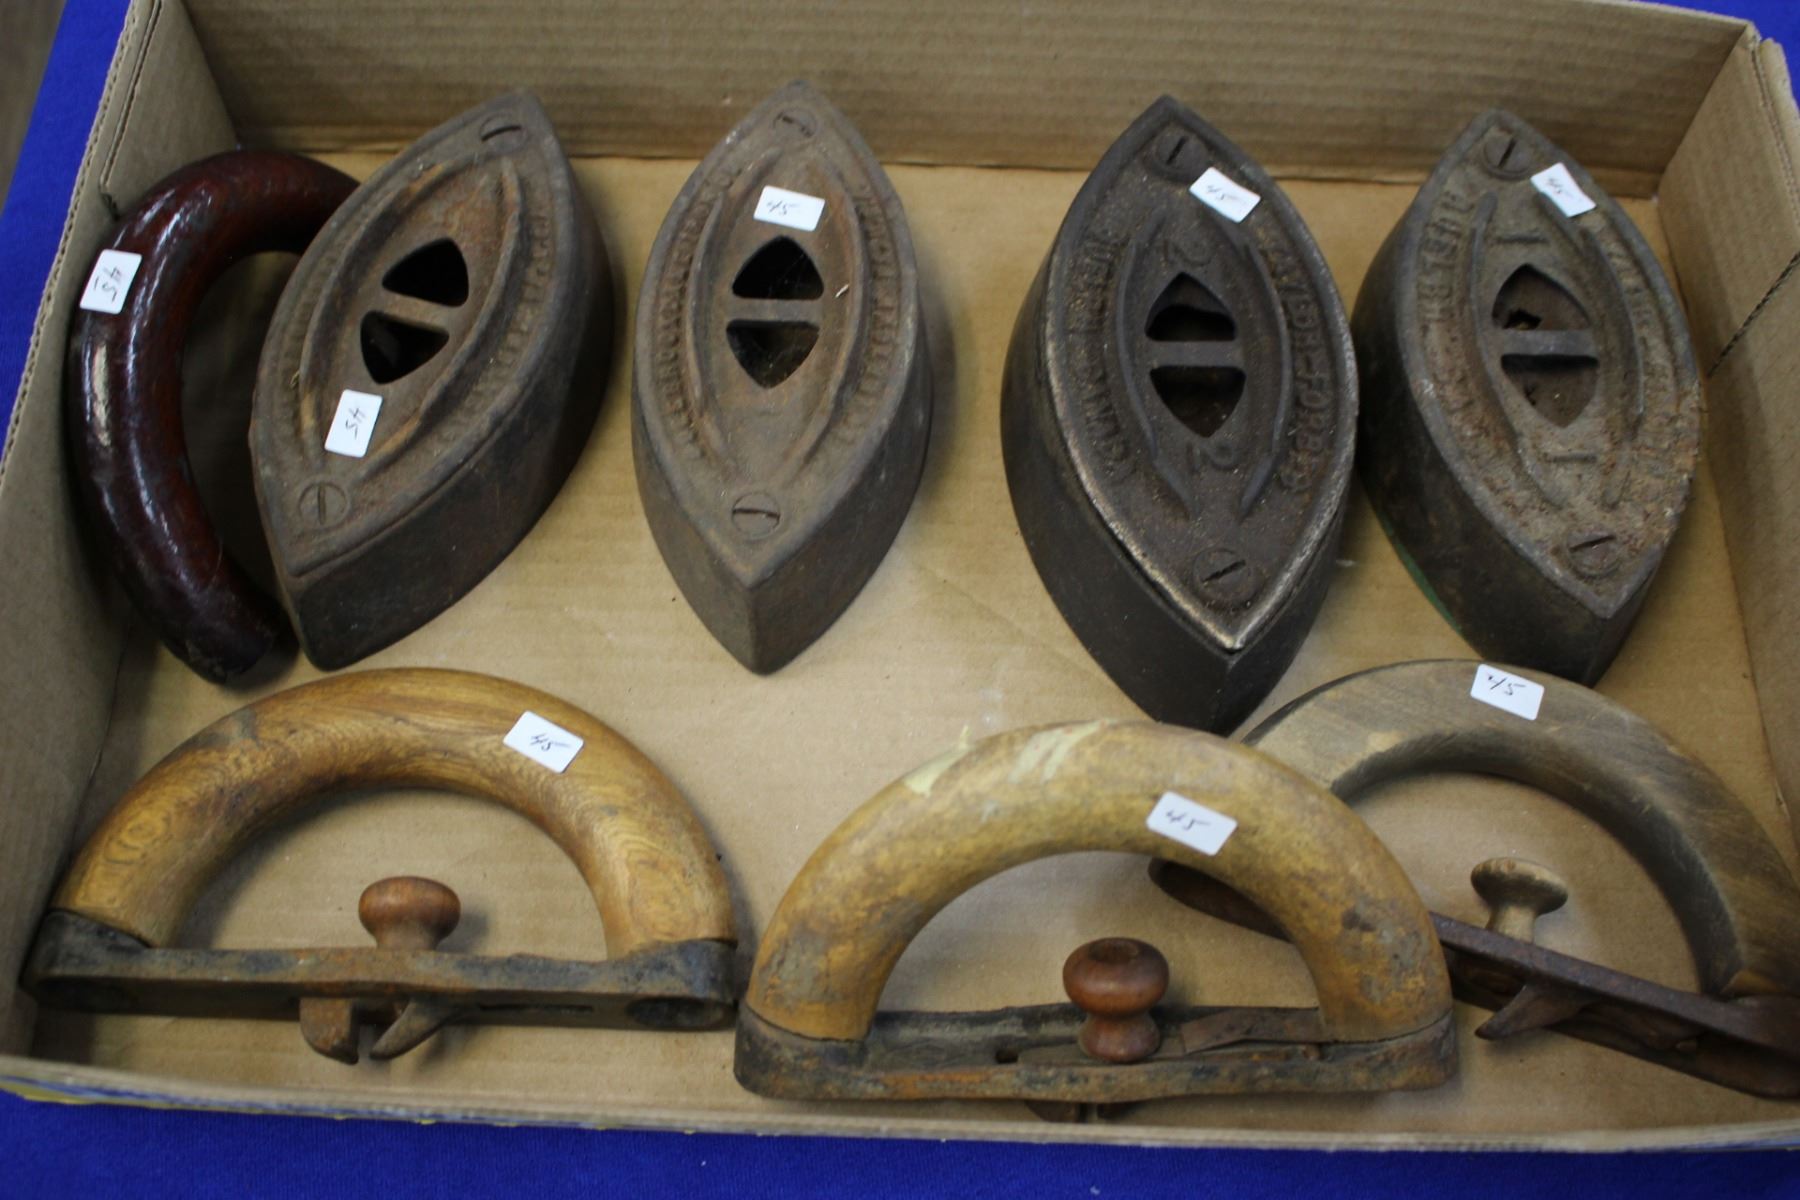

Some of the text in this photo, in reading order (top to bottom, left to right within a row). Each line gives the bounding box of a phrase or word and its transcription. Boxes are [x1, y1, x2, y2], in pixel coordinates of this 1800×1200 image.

[766, 198, 799, 217] 45
[93, 265, 123, 303] 45
[344, 406, 366, 440] 45
[1486, 673, 1527, 697] 45
[529, 731, 572, 752] 45
[1164, 810, 1211, 831] 45
